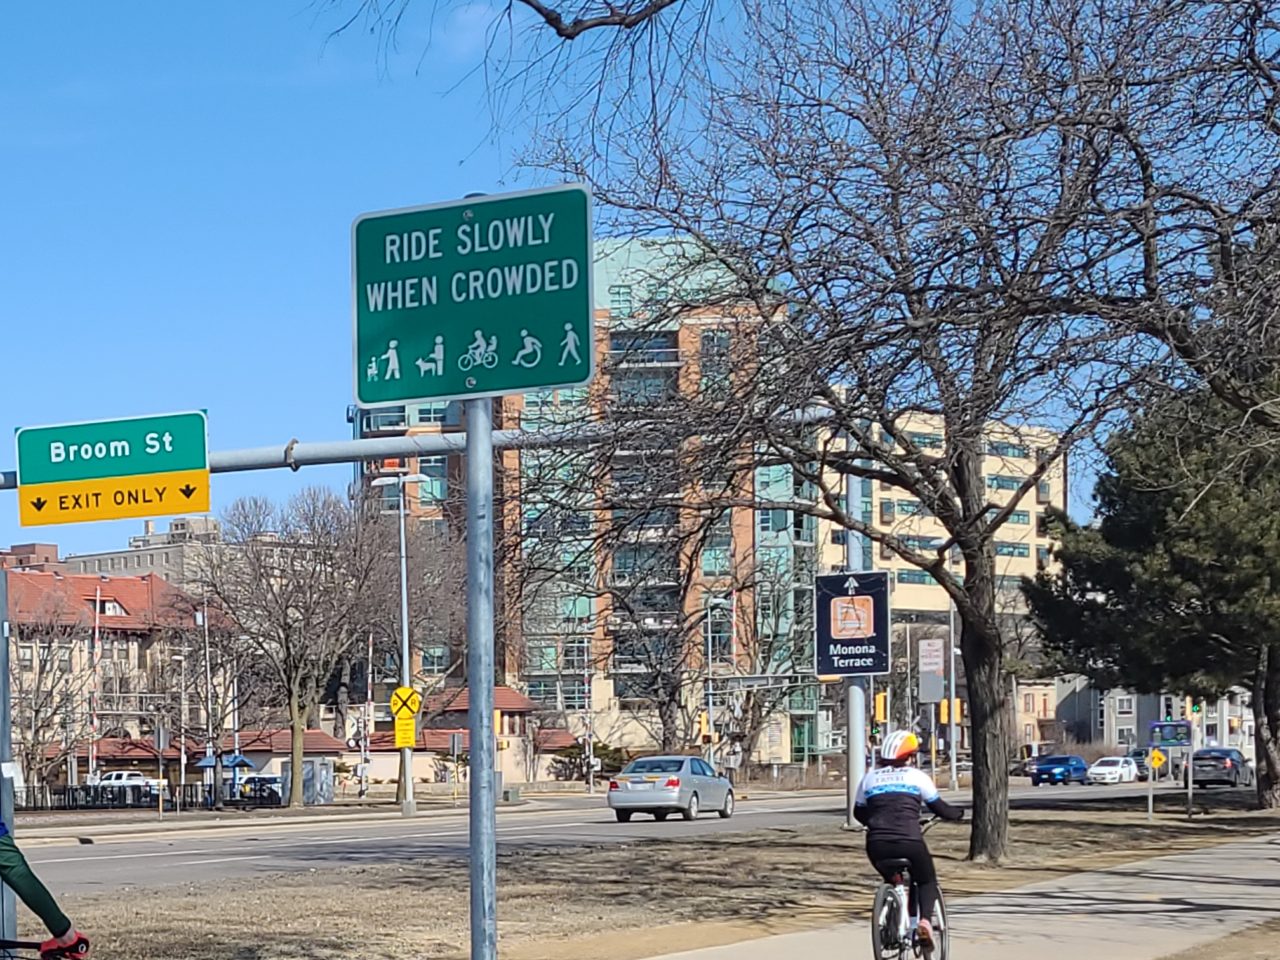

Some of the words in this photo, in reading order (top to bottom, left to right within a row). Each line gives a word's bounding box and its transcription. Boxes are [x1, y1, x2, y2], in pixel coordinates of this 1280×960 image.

[385, 228, 443, 264] RIDE
[456, 212, 555, 255] SLOWLY
[366, 276, 438, 313] WHEN
[451, 258, 579, 302] CROWDED
[50, 440, 130, 463] Broom
[145, 431, 173, 454] St
[59, 492, 102, 511] EXIT
[113, 486, 168, 505] ONLY
[829, 644, 876, 655] Monona
[832, 656, 874, 668] Terrace
